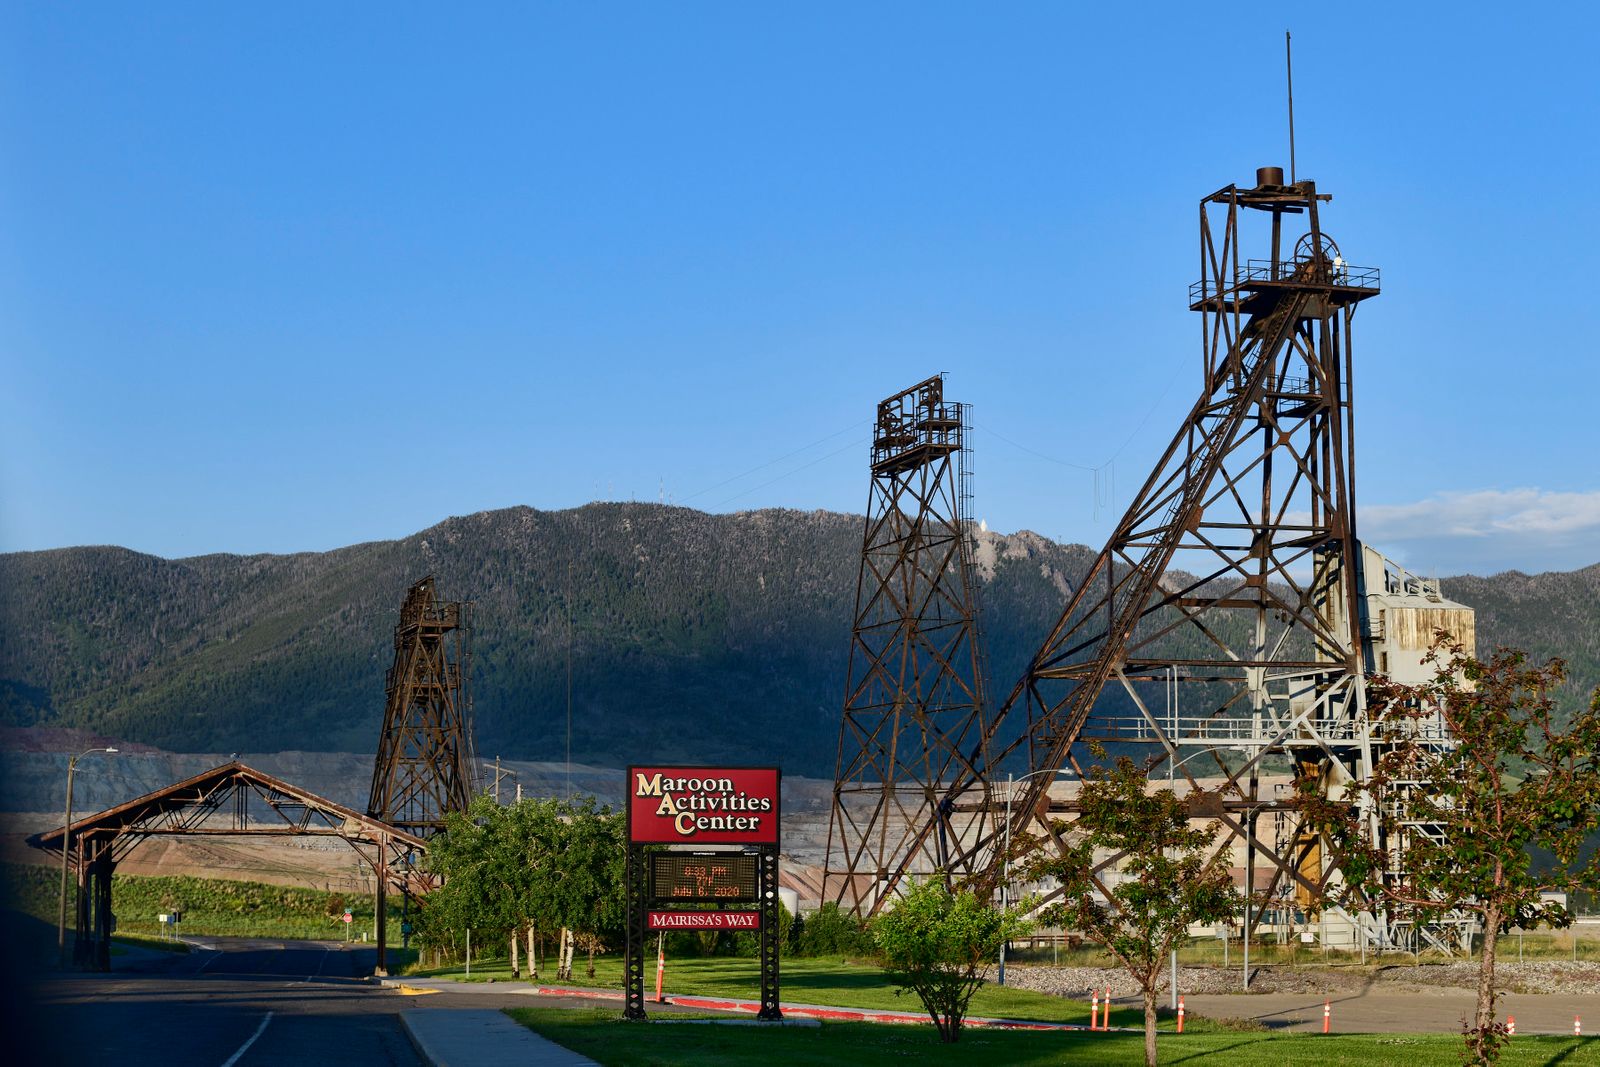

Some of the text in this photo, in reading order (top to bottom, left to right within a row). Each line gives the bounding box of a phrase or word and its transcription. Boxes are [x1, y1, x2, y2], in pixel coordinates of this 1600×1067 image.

[636, 773, 733, 796] Maroon
[656, 792, 770, 815] Activities
[675, 811, 759, 835] Center
[711, 866, 727, 876] PM
[672, 886, 692, 897] July
[714, 886, 740, 897] 2020
[652, 914, 755, 927] MAIRISSA'S WAY
